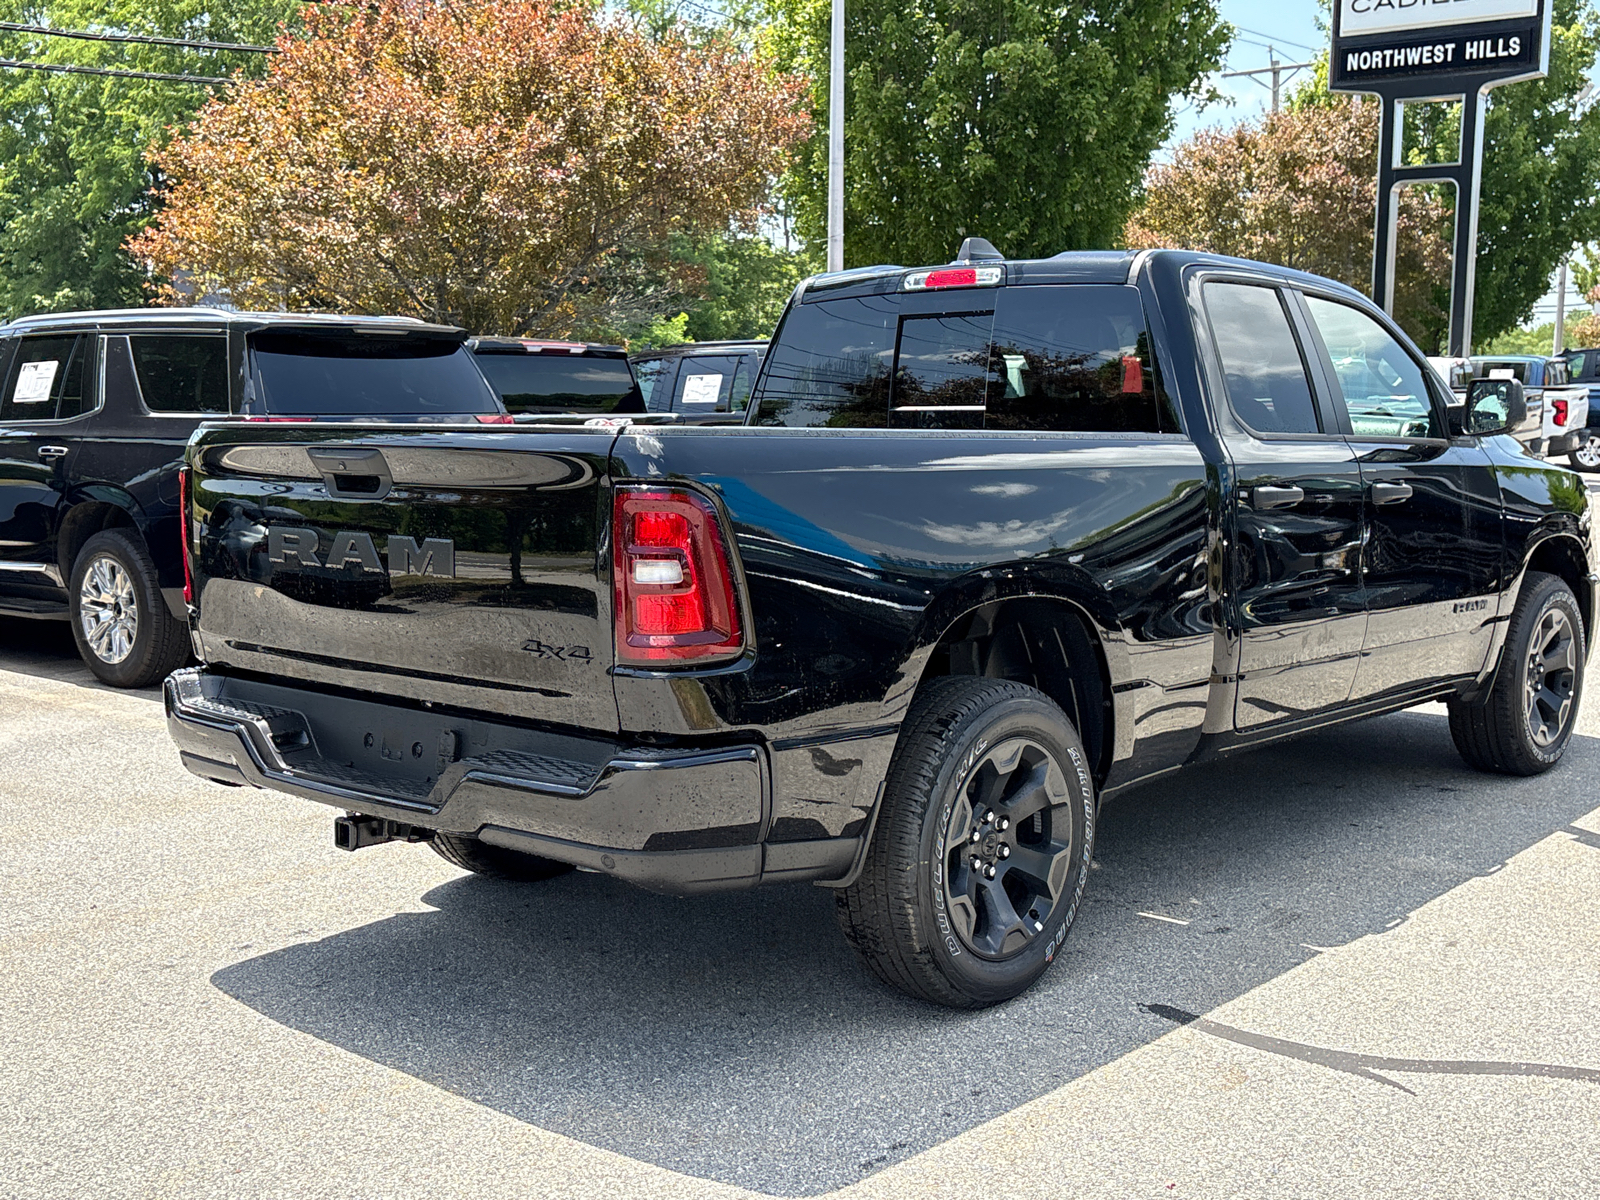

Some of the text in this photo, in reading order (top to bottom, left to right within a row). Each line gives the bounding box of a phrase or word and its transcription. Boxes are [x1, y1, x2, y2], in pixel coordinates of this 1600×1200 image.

[1347, 37, 1521, 71] NORTHWEST HILLS
[268, 526, 456, 579] RAM
[1452, 599, 1488, 614] RAM
